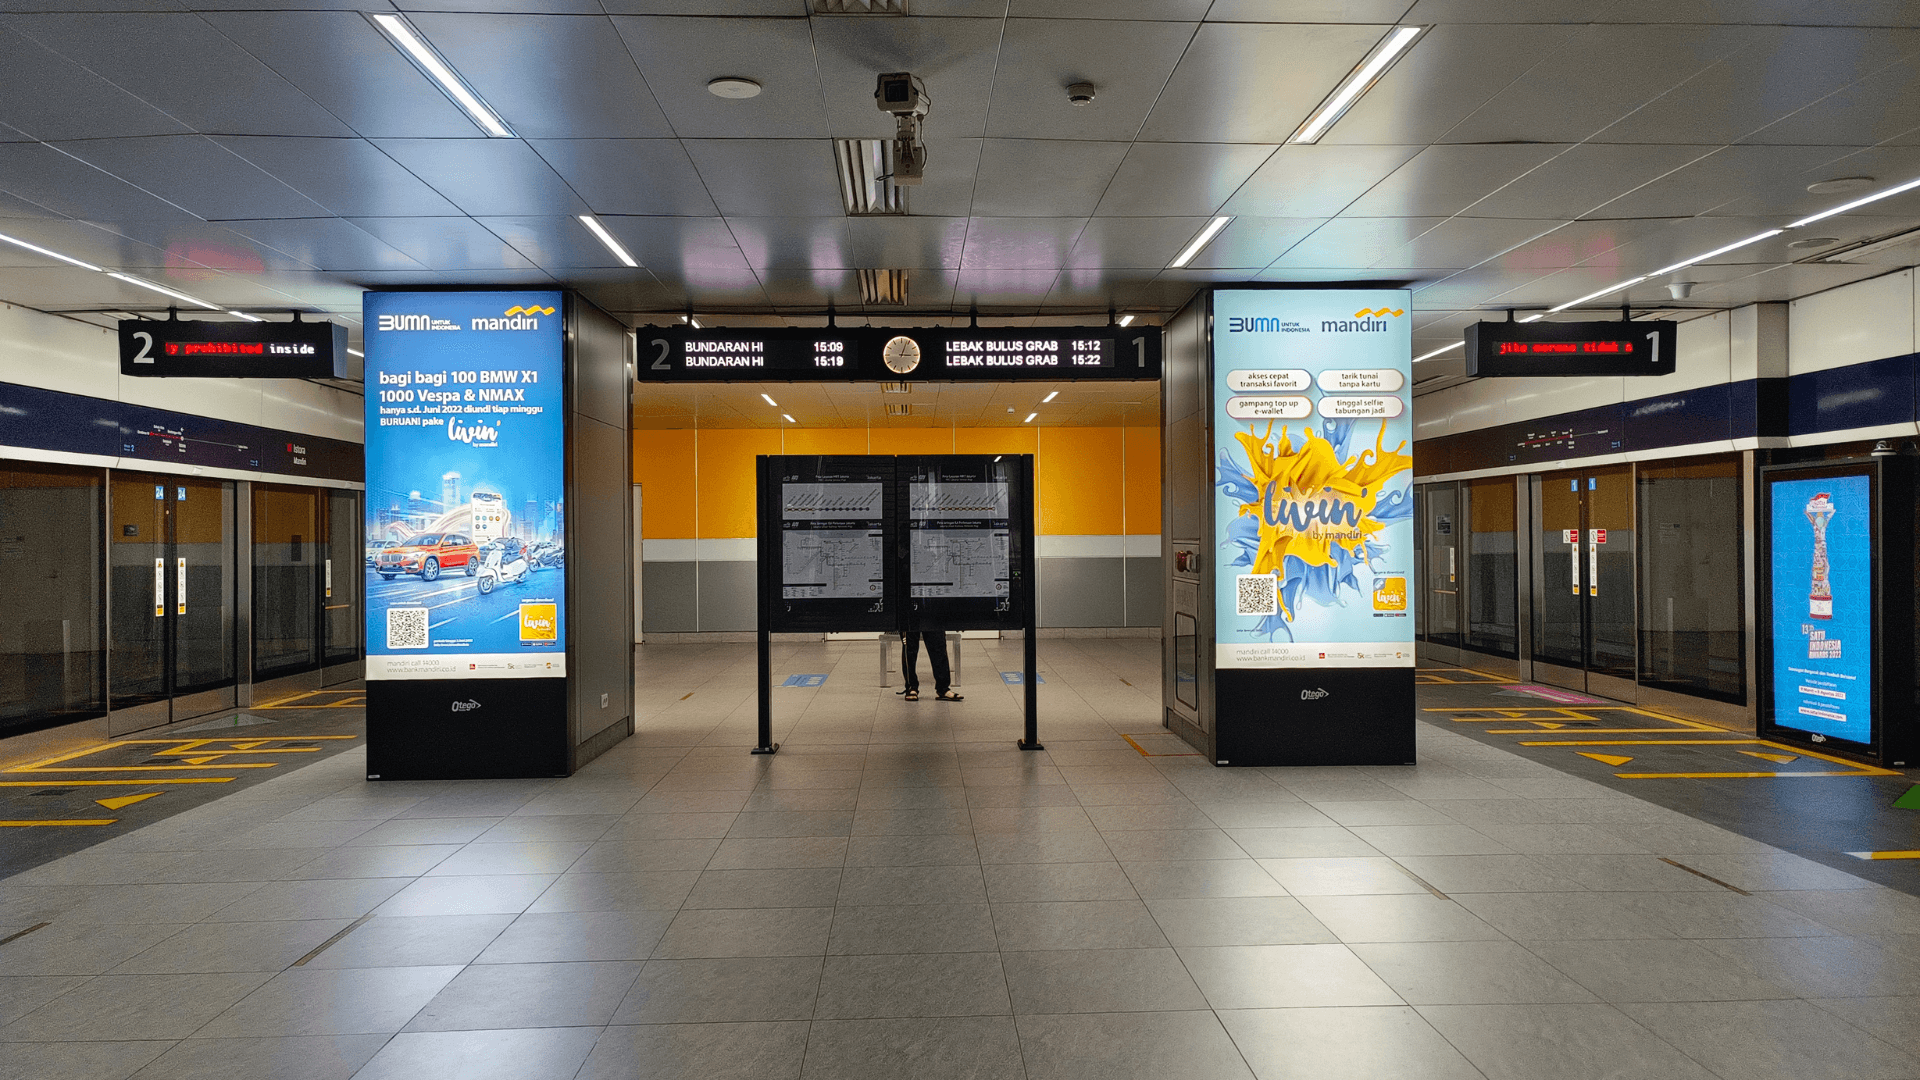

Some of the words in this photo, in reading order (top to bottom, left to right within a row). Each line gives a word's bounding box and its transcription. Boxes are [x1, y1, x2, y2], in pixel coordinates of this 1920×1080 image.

[378, 315, 430, 331] BUMN
[472, 315, 538, 330] mandiri
[1229, 317, 1280, 333] BUMN
[1322, 317, 1387, 332] mandiri
[132, 331, 154, 364] 2
[185, 342, 263, 355] prohibited
[270, 343, 315, 354] inside
[686, 342, 750, 352] BUNDARAN
[752, 342, 763, 352] HI
[813, 342, 843, 352] 15:09
[946, 341, 983, 351] LEBAK
[986, 341, 1022, 351] BULUS
[1025, 341, 1058, 351] GRAB
[1071, 341, 1101, 351] 15:12
[1646, 331, 1659, 362] 1
[650, 339, 671, 370] 2
[1132, 336, 1146, 368] 1
[686, 356, 750, 367] BUNDARAN
[752, 356, 763, 367] HI
[813, 356, 843, 367] 15:19
[946, 355, 983, 366] LEBAK
[986, 355, 1022, 366] BULUS
[1025, 355, 1058, 366] GRAB
[1071, 355, 1101, 365] 15:22
[379, 371, 411, 387] bagi
[415, 371, 447, 387] bagi
[451, 371, 477, 384] 100
[480, 371, 518, 383] BMW
[521, 370, 538, 383] X1
[1269, 373, 1289, 381] cepat
[1339, 381, 1360, 389] tanpa
[380, 390, 414, 402] 1000
[417, 389, 460, 404] Vespa
[464, 389, 475, 401] &
[479, 389, 525, 401] NMAX
[1275, 400, 1287, 408] top
[1337, 399, 1363, 408] tinggal
[380, 406, 406, 416] hanya
[407, 405, 421, 413] s.d.
[423, 405, 440, 414] Juni
[442, 405, 463, 413] 2022
[464, 405, 491, 413] diundi
[492, 405, 509, 415] tiap
[510, 405, 543, 415] minggu
[1335, 408, 1370, 416] tabungan
[1371, 408, 1385, 416] jadi
[422, 417, 444, 427] pake
[155, 487, 163, 498] 24
[178, 488, 186, 499] 24
[1313, 530, 1323, 541] by
[1325, 530, 1362, 539] mandiri
[1810, 630, 1826, 640] SATU
[1809, 640, 1841, 651] INDONESIA
[1301, 688, 1324, 700] Otego
[451, 700, 476, 712] Otego
